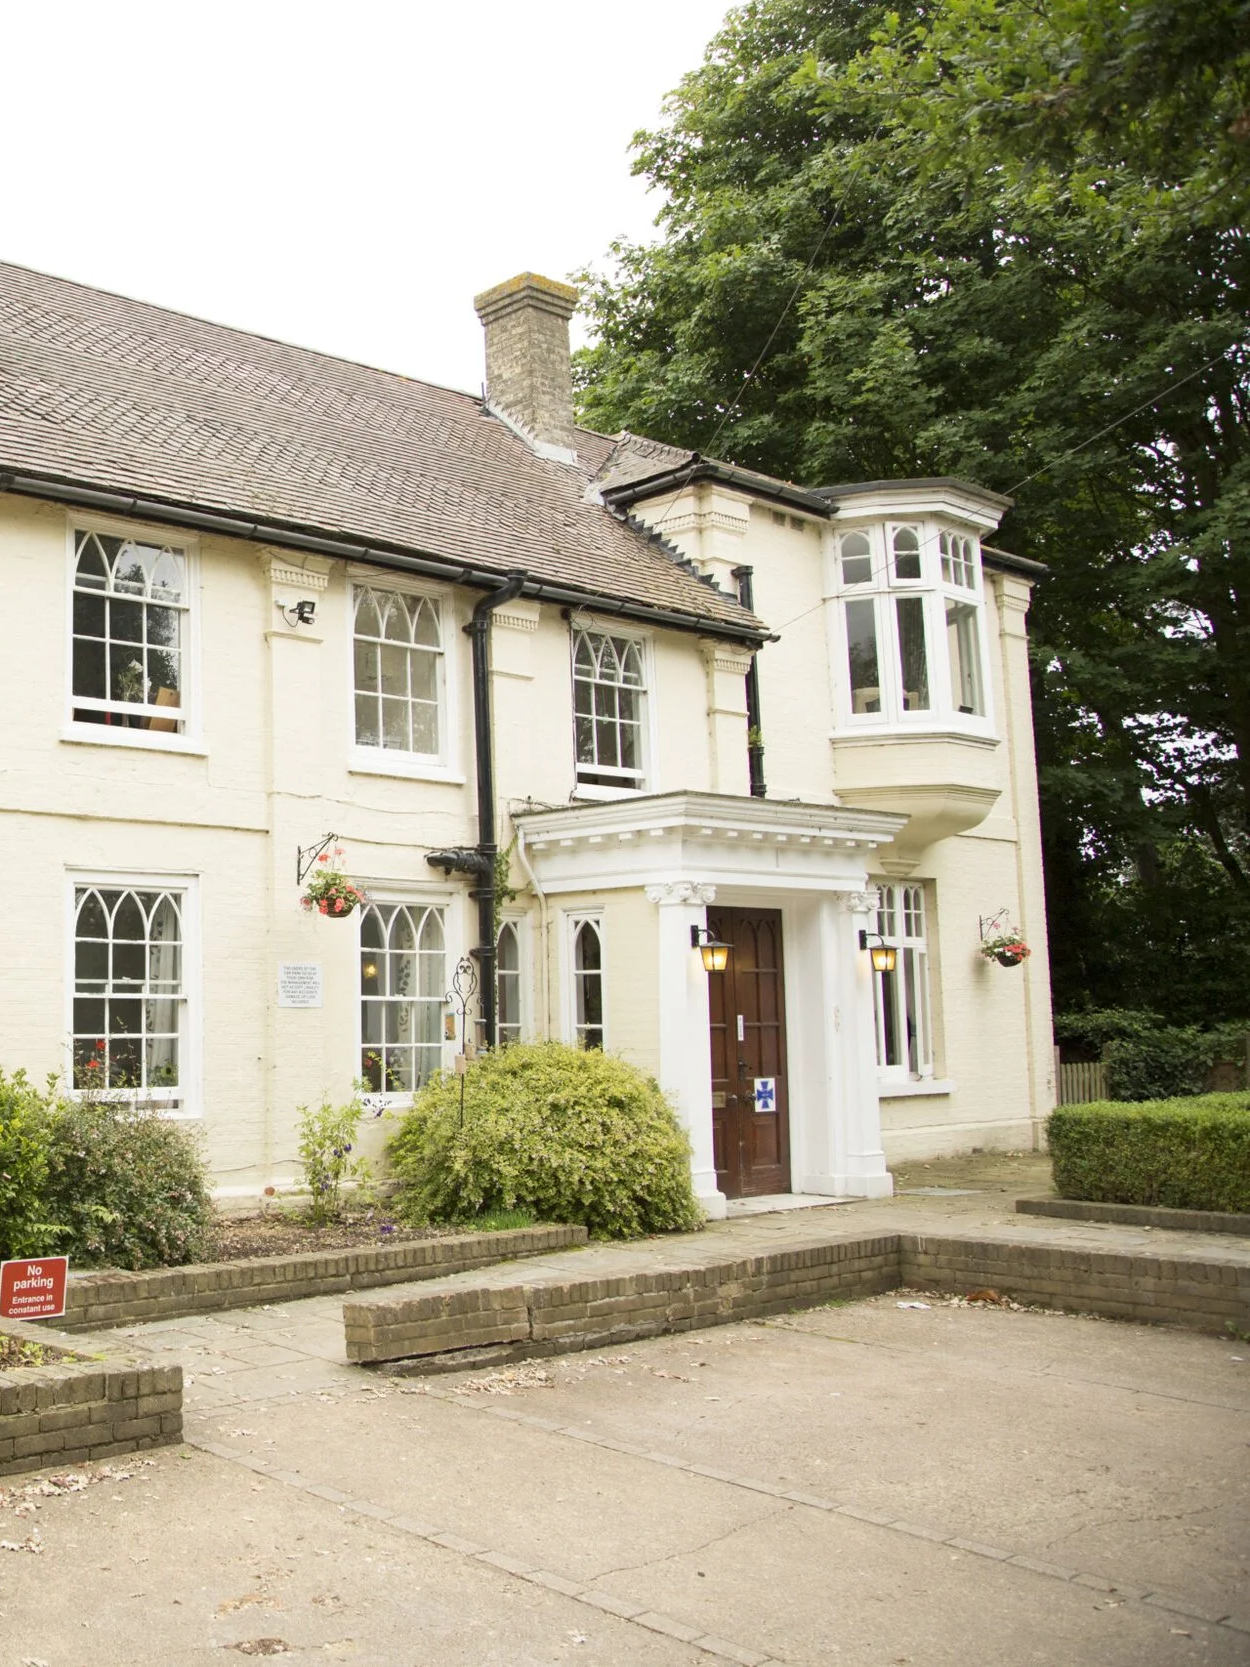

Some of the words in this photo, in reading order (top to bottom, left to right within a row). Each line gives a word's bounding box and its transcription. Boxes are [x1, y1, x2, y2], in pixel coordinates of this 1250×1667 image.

[27, 1264, 42, 1276] No
[13, 1277, 54, 1292] parking
[12, 1295, 45, 1304] Entrance
[46, 1293, 53, 1301] in
[8, 1305, 41, 1314] constant
[42, 1304, 55, 1312] use
